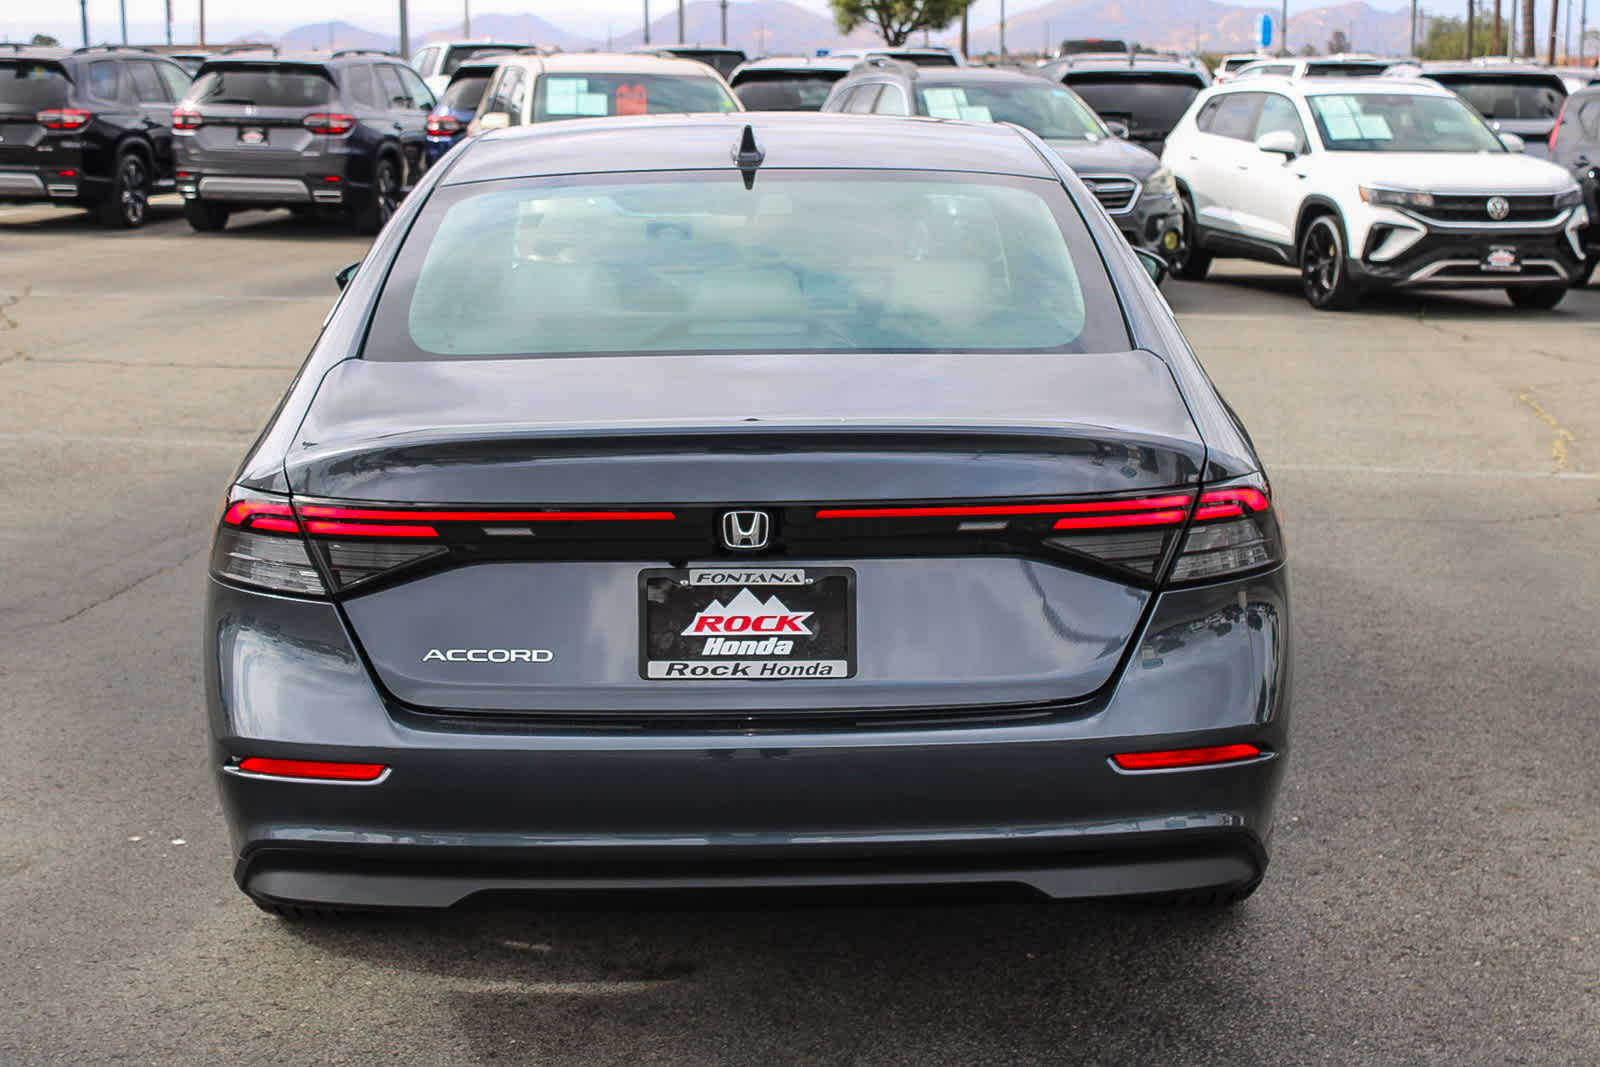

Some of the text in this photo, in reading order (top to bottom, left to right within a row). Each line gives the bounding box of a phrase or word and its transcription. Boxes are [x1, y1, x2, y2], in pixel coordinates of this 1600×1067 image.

[696, 573, 801, 584] FONTANA
[694, 615, 804, 633] ROCK
[701, 637, 794, 656] Honda
[422, 649, 554, 662] ACCORD
[665, 663, 833, 677] Rock Honda
